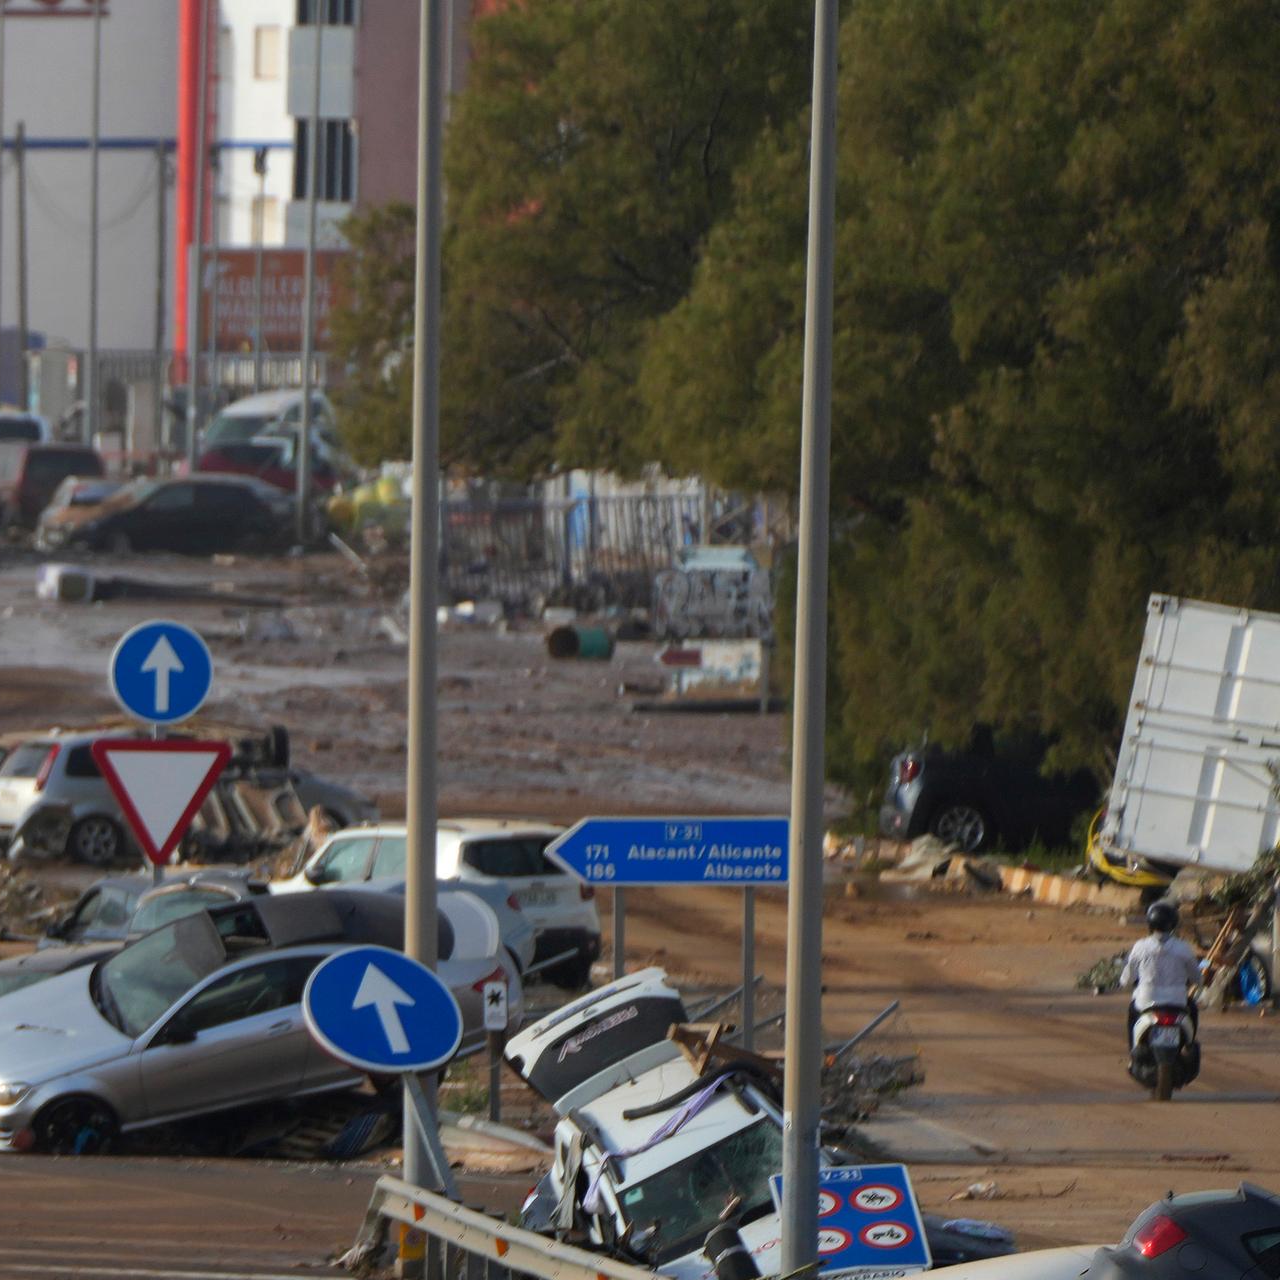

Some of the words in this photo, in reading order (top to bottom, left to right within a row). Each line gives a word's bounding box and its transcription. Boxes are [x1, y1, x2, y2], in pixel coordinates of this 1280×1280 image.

[669, 825, 701, 840] V-31
[586, 845, 609, 860] 171
[586, 864, 616, 879] 186
[704, 863, 782, 879] Albacete
